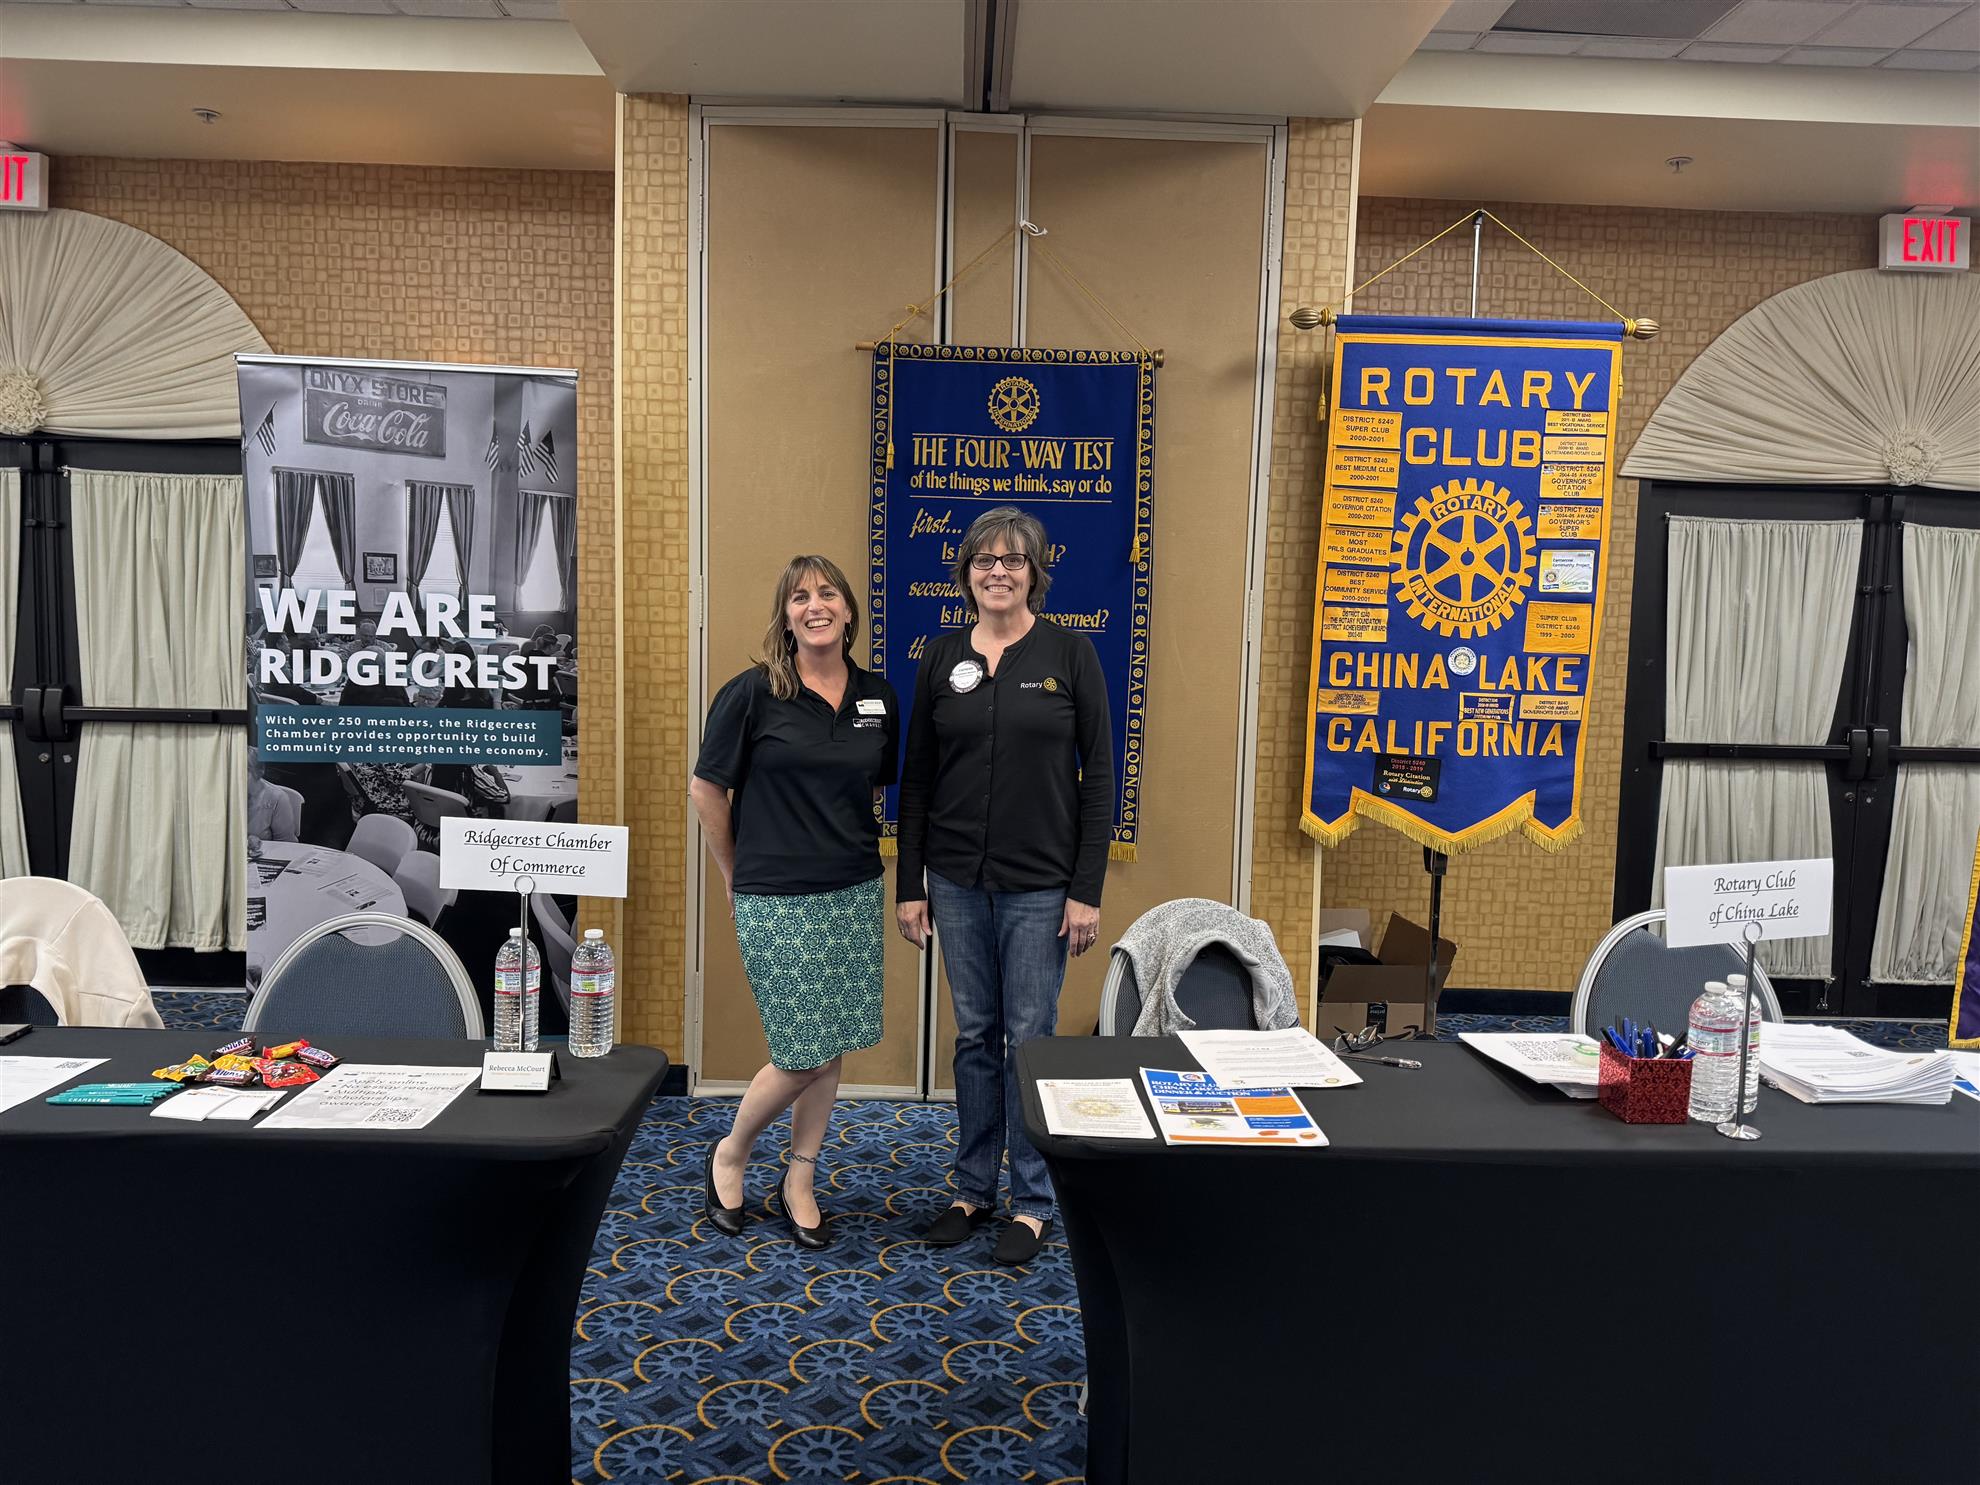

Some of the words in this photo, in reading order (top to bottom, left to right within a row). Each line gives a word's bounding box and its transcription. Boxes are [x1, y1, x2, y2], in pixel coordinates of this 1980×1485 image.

[1904, 218, 1960, 264] EXIT
[310, 371, 364, 395] ONYX
[371, 380, 435, 405] STORE
[1000, 381, 1030, 390] ROTARY
[1360, 367, 1596, 409] ROTARY
[1343, 416, 1375, 424] DISTRICT
[912, 438, 948, 466] THE
[956, 438, 1066, 469] FOUR-WAY
[1074, 441, 1114, 470] TEST
[1405, 427, 1541, 468] CLUB
[910, 471, 926, 488] of
[927, 472, 948, 489] the
[950, 473, 990, 495] things
[994, 476, 1012, 491] we
[1053, 478, 1076, 498] say
[1079, 480, 1093, 493] or
[1095, 475, 1112, 493] do
[1332, 504, 1364, 512] GOVERNOR
[1433, 495, 1506, 521] ROTARY
[909, 508, 962, 538] first...
[1336, 530, 1366, 538] DISTRICT
[942, 542, 954, 560] Is
[1347, 548, 1386, 556] GRADUATES
[1410, 578, 1514, 622] INTERNATIONAL
[258, 588, 356, 635] WE
[376, 591, 497, 639] ARE
[941, 605, 952, 624] Is
[954, 606, 962, 624] it
[260, 649, 557, 691] RIDGECREST
[1328, 652, 1450, 689] CHINA
[1479, 655, 1581, 692] LAKE
[1020, 681, 1043, 691] Rotary
[266, 715, 296, 726] With
[302, 717, 332, 726] over
[338, 717, 362, 726] 250
[367, 717, 433, 730] members,
[439, 718, 461, 728] the
[466, 720, 537, 732] Ridgecrest
[266, 728, 326, 739] Chamber
[331, 730, 391, 742] provides
[397, 731, 478, 744] opportunity
[484, 732, 497, 742] to
[502, 732, 536, 743] build
[1327, 716, 1564, 757] CALIFORNIA
[266, 742, 342, 754] community
[348, 743, 372, 753] and
[378, 744, 453, 756] strengthen
[458, 745, 480, 755] the
[486, 747, 549, 758] economy.
[464, 829, 541, 850] Ridgecrest
[546, 832, 612, 850] Chamber
[490, 856, 511, 876] Of
[513, 859, 586, 874] Commerce
[1714, 878, 1761, 896] Rotary
[1766, 870, 1796, 889] Club
[1710, 904, 1724, 928] of
[1726, 902, 1764, 920] China
[1768, 899, 1799, 917] Lake
[517, 1065, 545, 1073] McCourt
